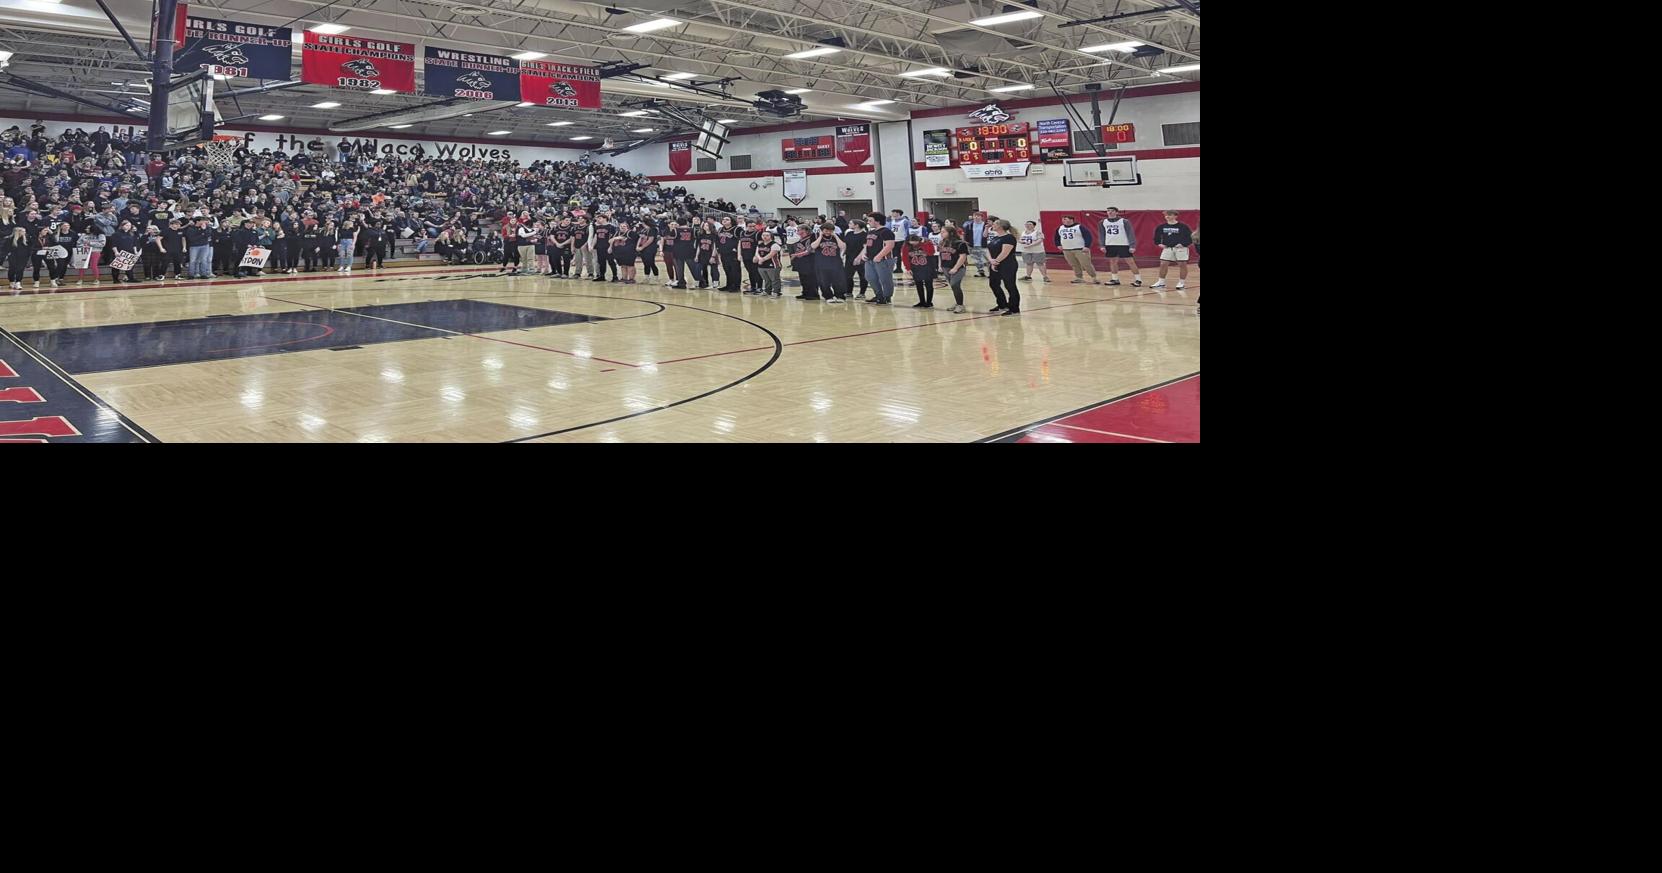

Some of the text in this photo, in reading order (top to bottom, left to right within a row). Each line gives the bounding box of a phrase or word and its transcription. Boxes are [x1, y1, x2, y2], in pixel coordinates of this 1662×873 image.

[186, 19, 277, 37] IRLS GOLF
[208, 31, 292, 47] RUNNER-UP
[318, 35, 401, 52] GIRLS GOLF
[303, 43, 415, 62] STATE CHAMPIONS
[437, 50, 510, 66] WRESTLING
[424, 57, 520, 74] STATE RUNNER-UP
[521, 61, 544, 70] GIRLS
[547, 64, 572, 73] TRACK
[580, 67, 600, 76] FIELD
[337, 77, 380, 88] 1982
[454, 88, 493, 100] 2006
[546, 96, 578, 106] 2013
[276, 134, 324, 151] the
[350, 138, 424, 156] Mlaca
[435, 141, 511, 159] Wolves
[1017, 138, 1026, 147] 0
